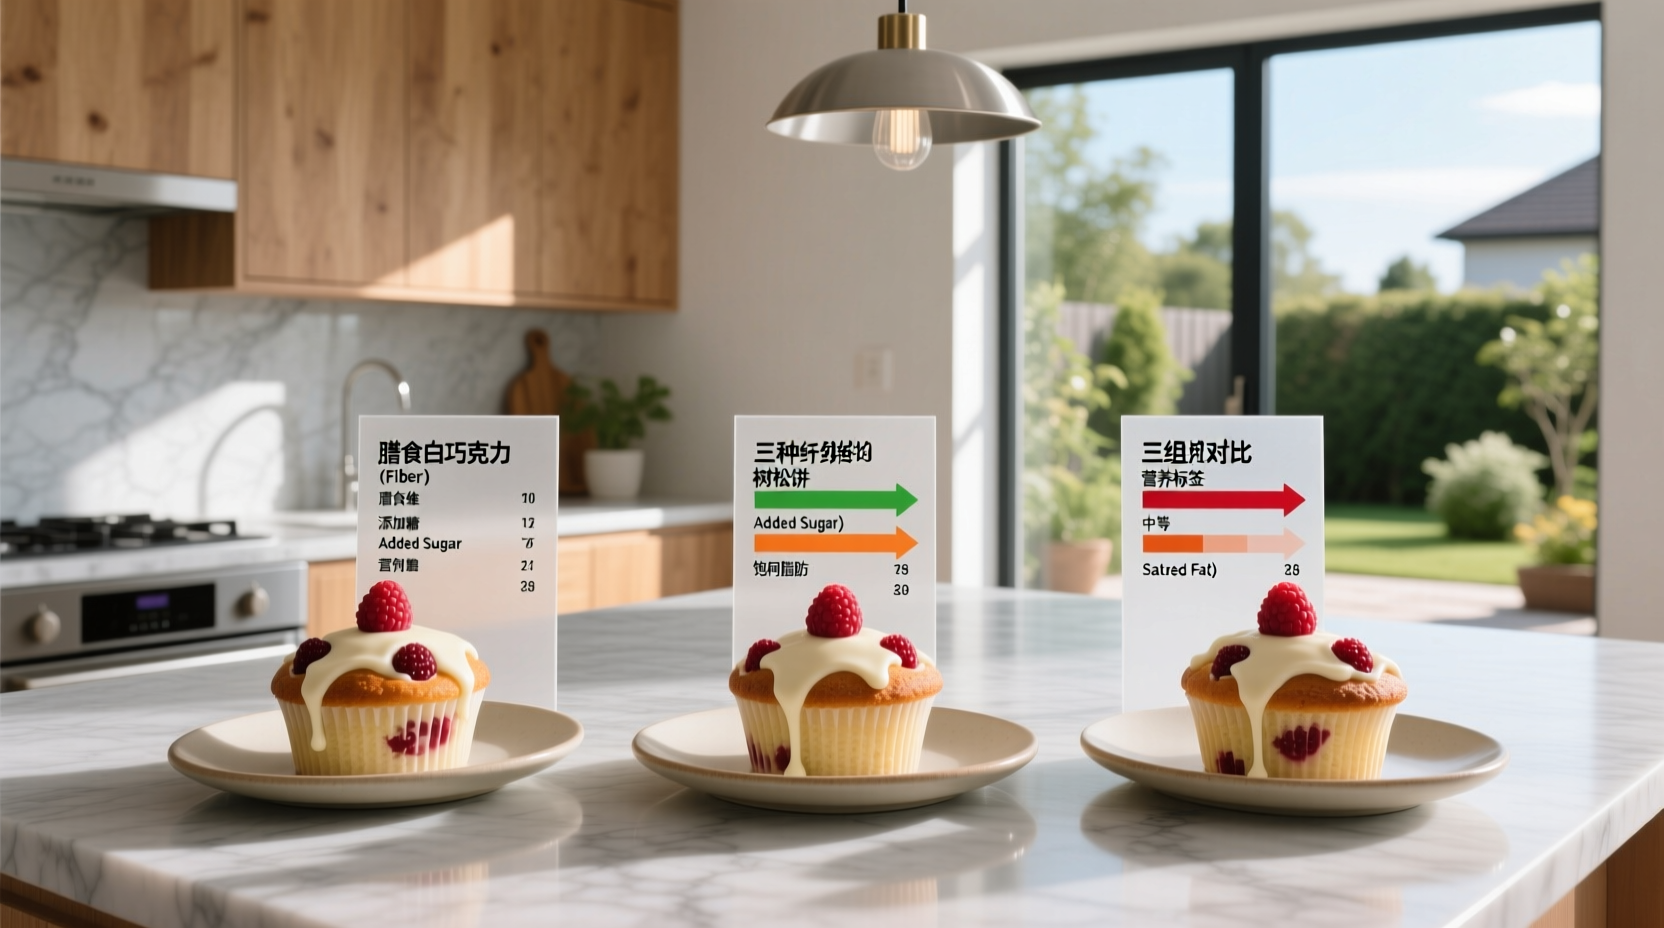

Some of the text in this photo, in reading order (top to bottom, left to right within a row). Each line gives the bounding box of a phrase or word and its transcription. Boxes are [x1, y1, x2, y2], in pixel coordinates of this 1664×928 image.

[378, 440, 511, 465] 膳食白巧克力
[379, 469, 430, 486] (Fiber)
[521, 492, 536, 504] 10
[754, 515, 845, 533] Added Sugar)
[378, 536, 463, 552] Added Sugar
[1191, 562, 1218, 579] Fat)
